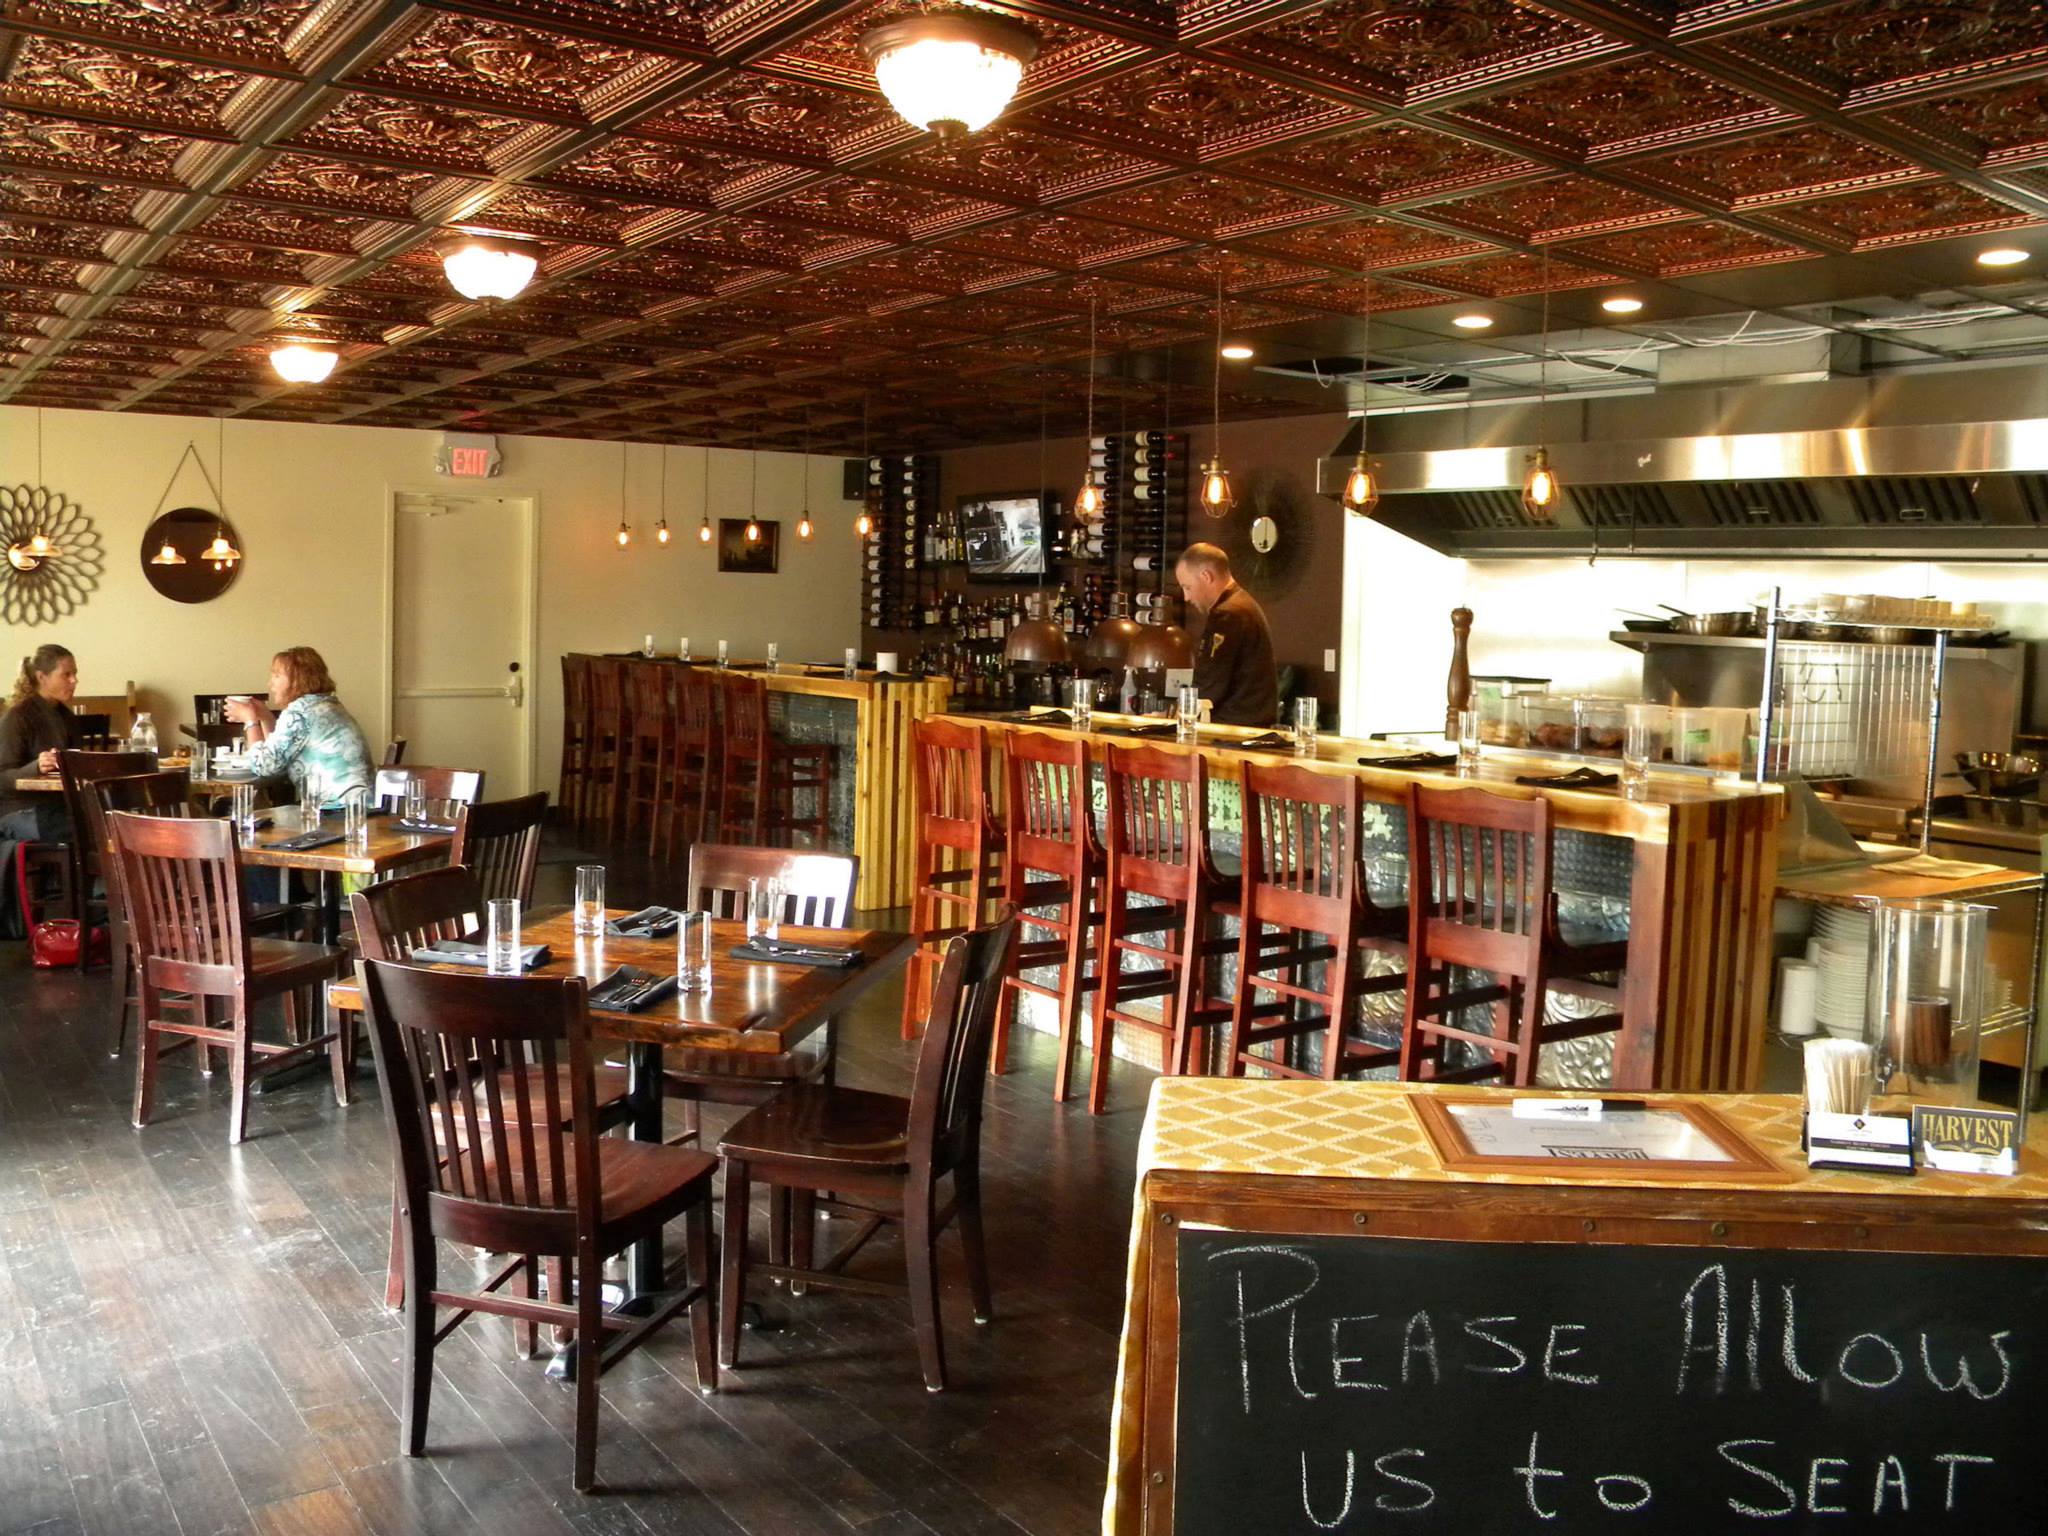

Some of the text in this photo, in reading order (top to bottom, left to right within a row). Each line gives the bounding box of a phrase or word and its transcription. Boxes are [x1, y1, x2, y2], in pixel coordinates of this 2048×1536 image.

[452, 447, 488, 475] EXIT
[1921, 1113, 2014, 1149] HARVEST
[1301, 1431, 1994, 1529] US to SEAT
